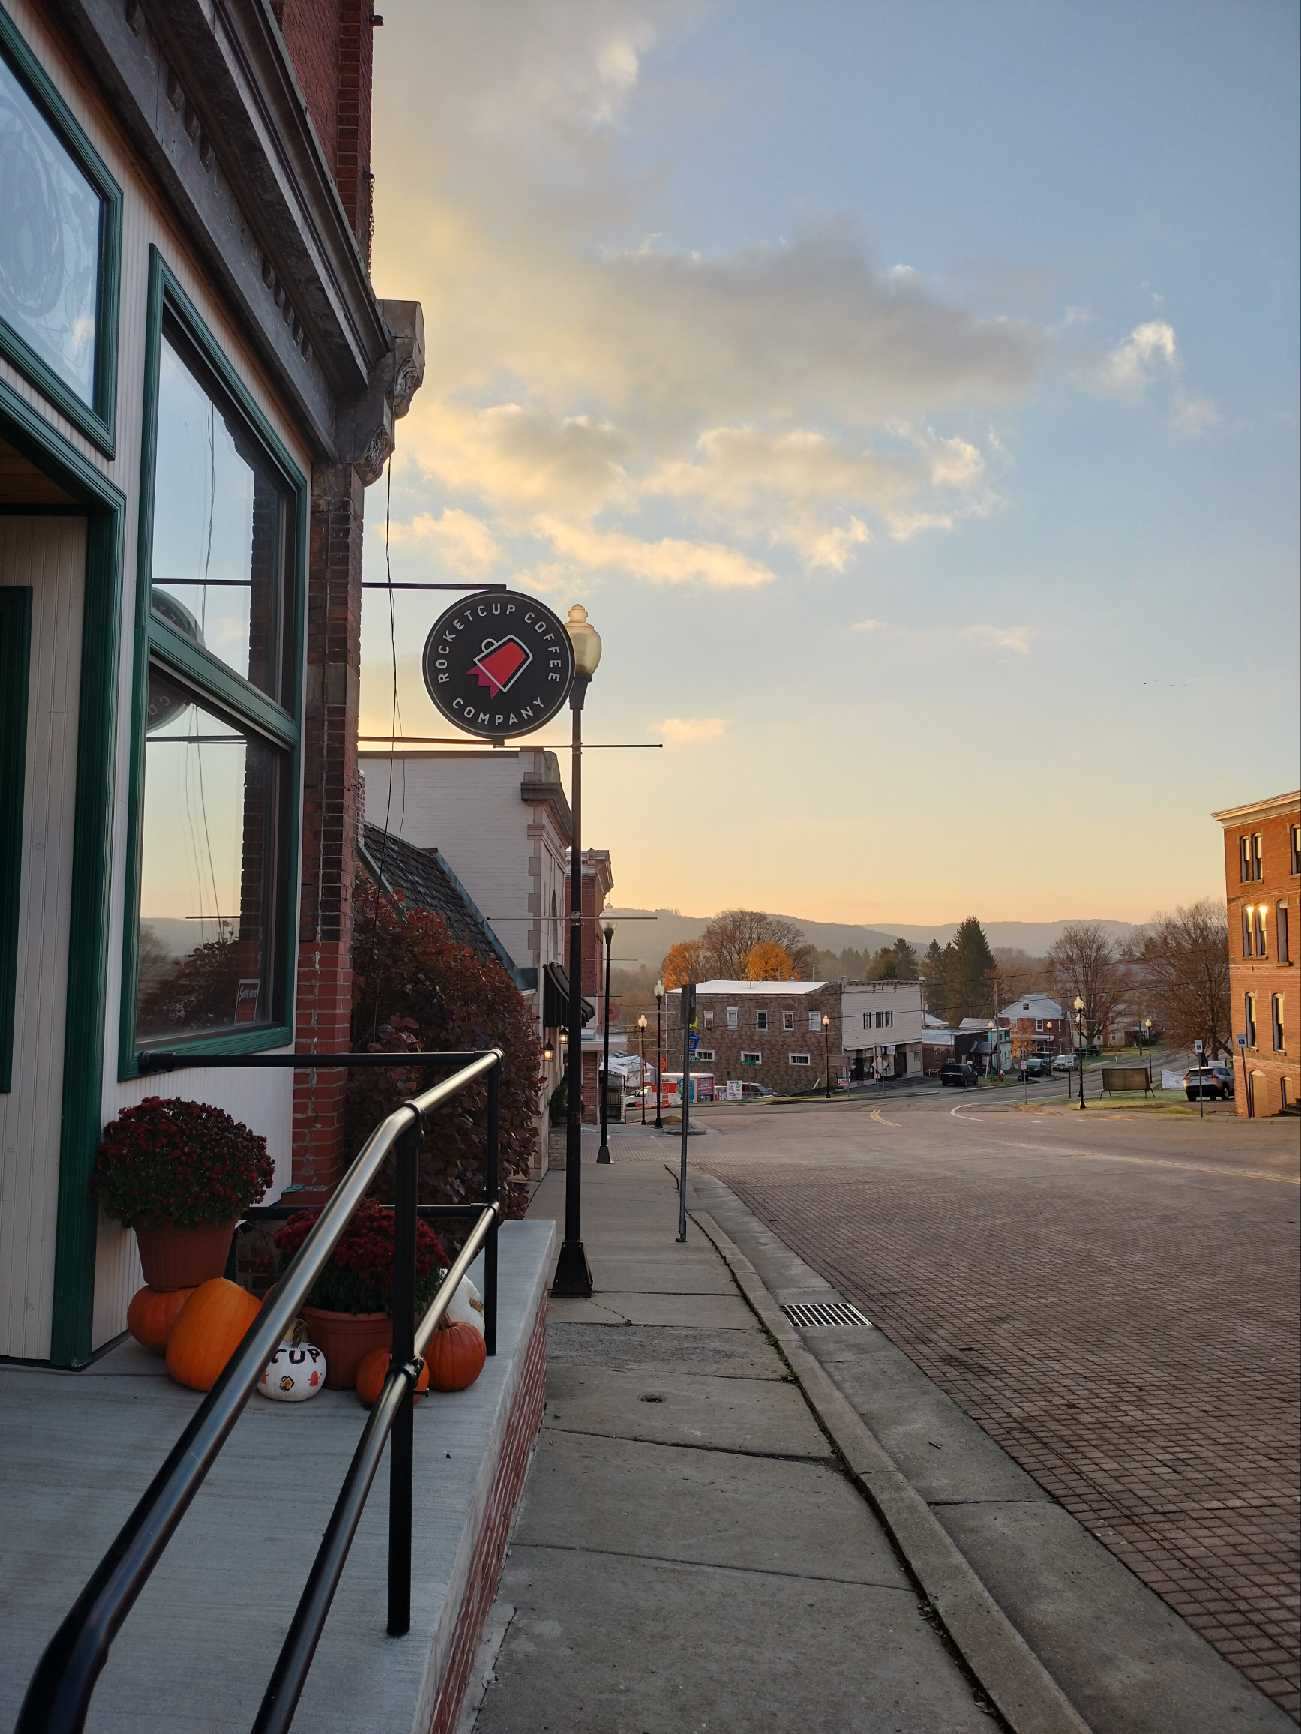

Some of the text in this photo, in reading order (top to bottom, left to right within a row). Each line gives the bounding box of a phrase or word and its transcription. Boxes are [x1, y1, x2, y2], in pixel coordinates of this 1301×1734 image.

[436, 603, 561, 683] ROCKETCUP COFFEE
[452, 697, 545, 725] COMPANY
